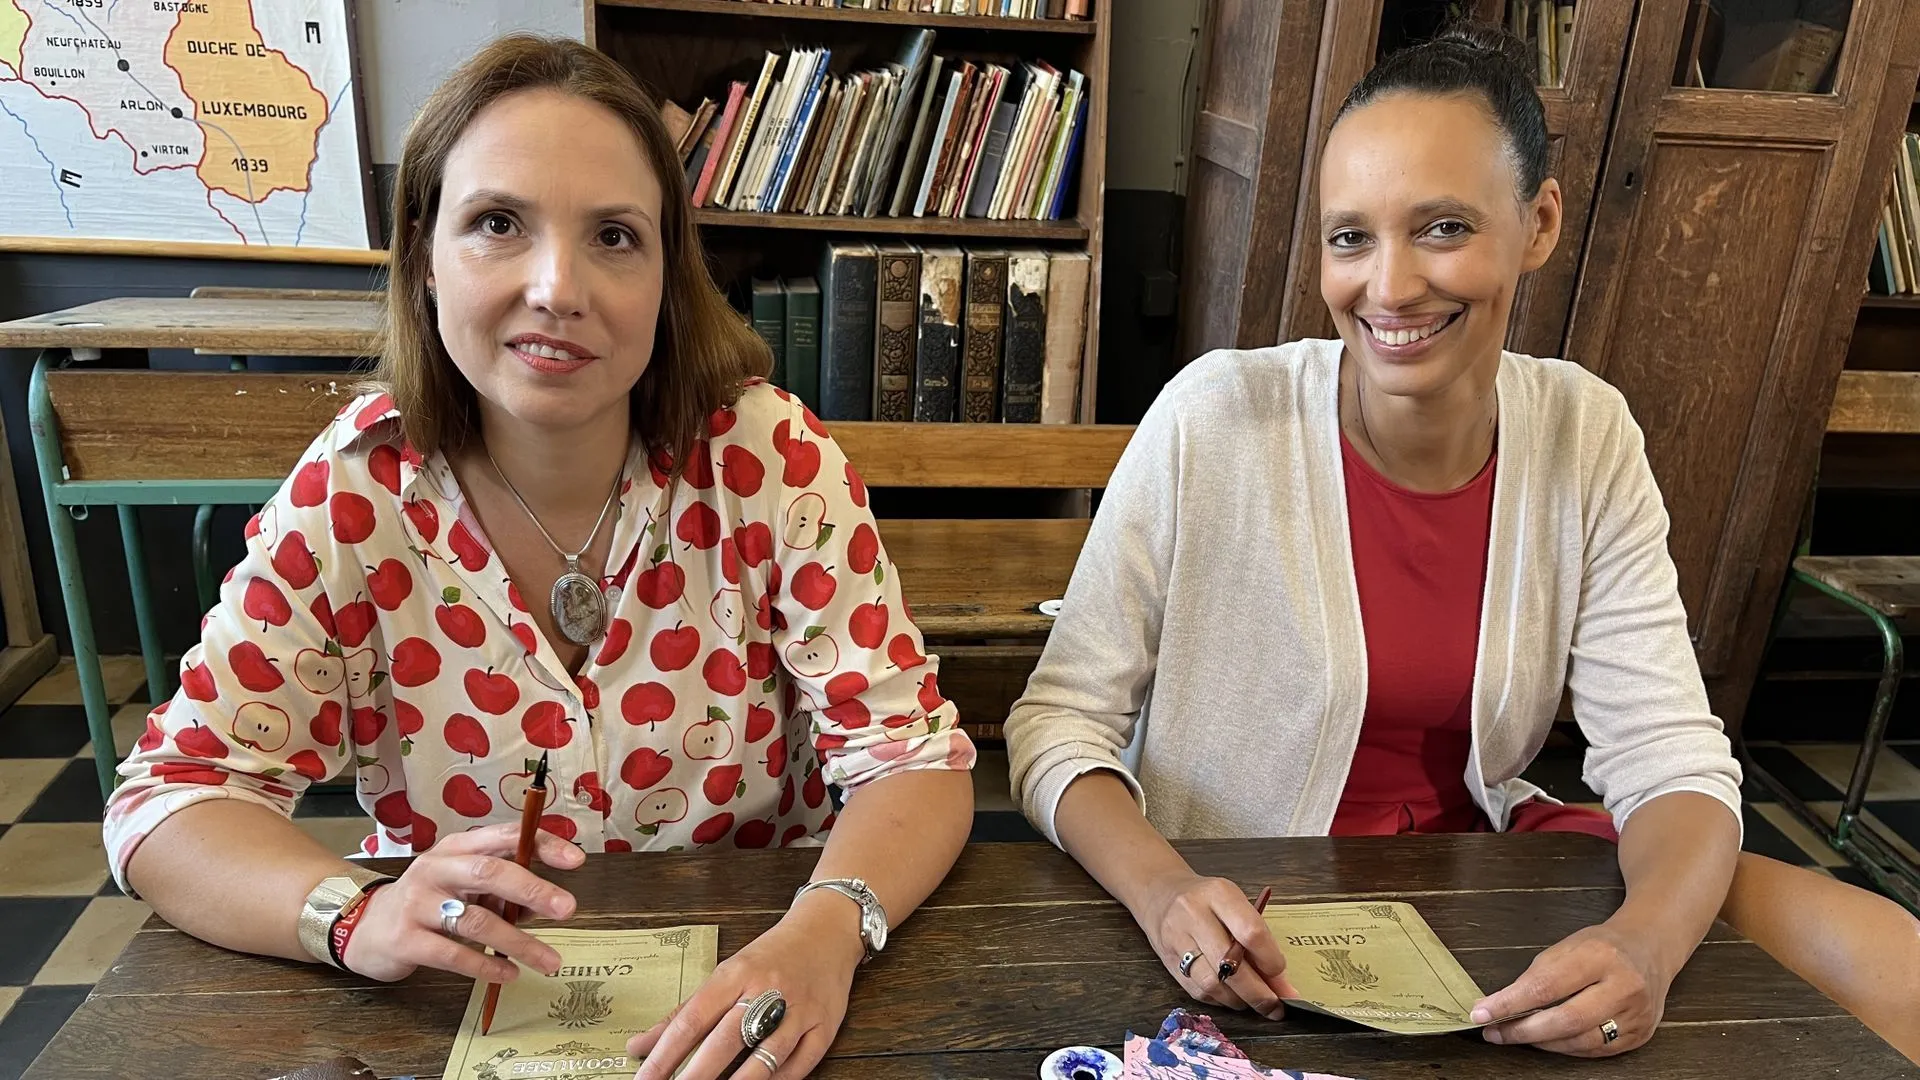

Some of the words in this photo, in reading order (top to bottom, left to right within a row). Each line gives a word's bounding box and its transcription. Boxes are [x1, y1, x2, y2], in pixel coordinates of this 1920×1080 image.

[154, 2, 209, 13] BASTOGNE
[46, 37, 121, 49] NEUFCHATEAU
[187, 40, 238, 55] DUCHE
[245, 43, 266, 57] DE
[34, 67, 85, 78] BOUILLON
[120, 99, 164, 111] ARLON
[202, 101, 307, 120] LUXEMBOURG
[152, 145, 189, 155] VIRTON
[231, 158, 269, 172] 1839
[333, 927, 349, 960] LUB
[1286, 934, 1366, 946] CAHIER
